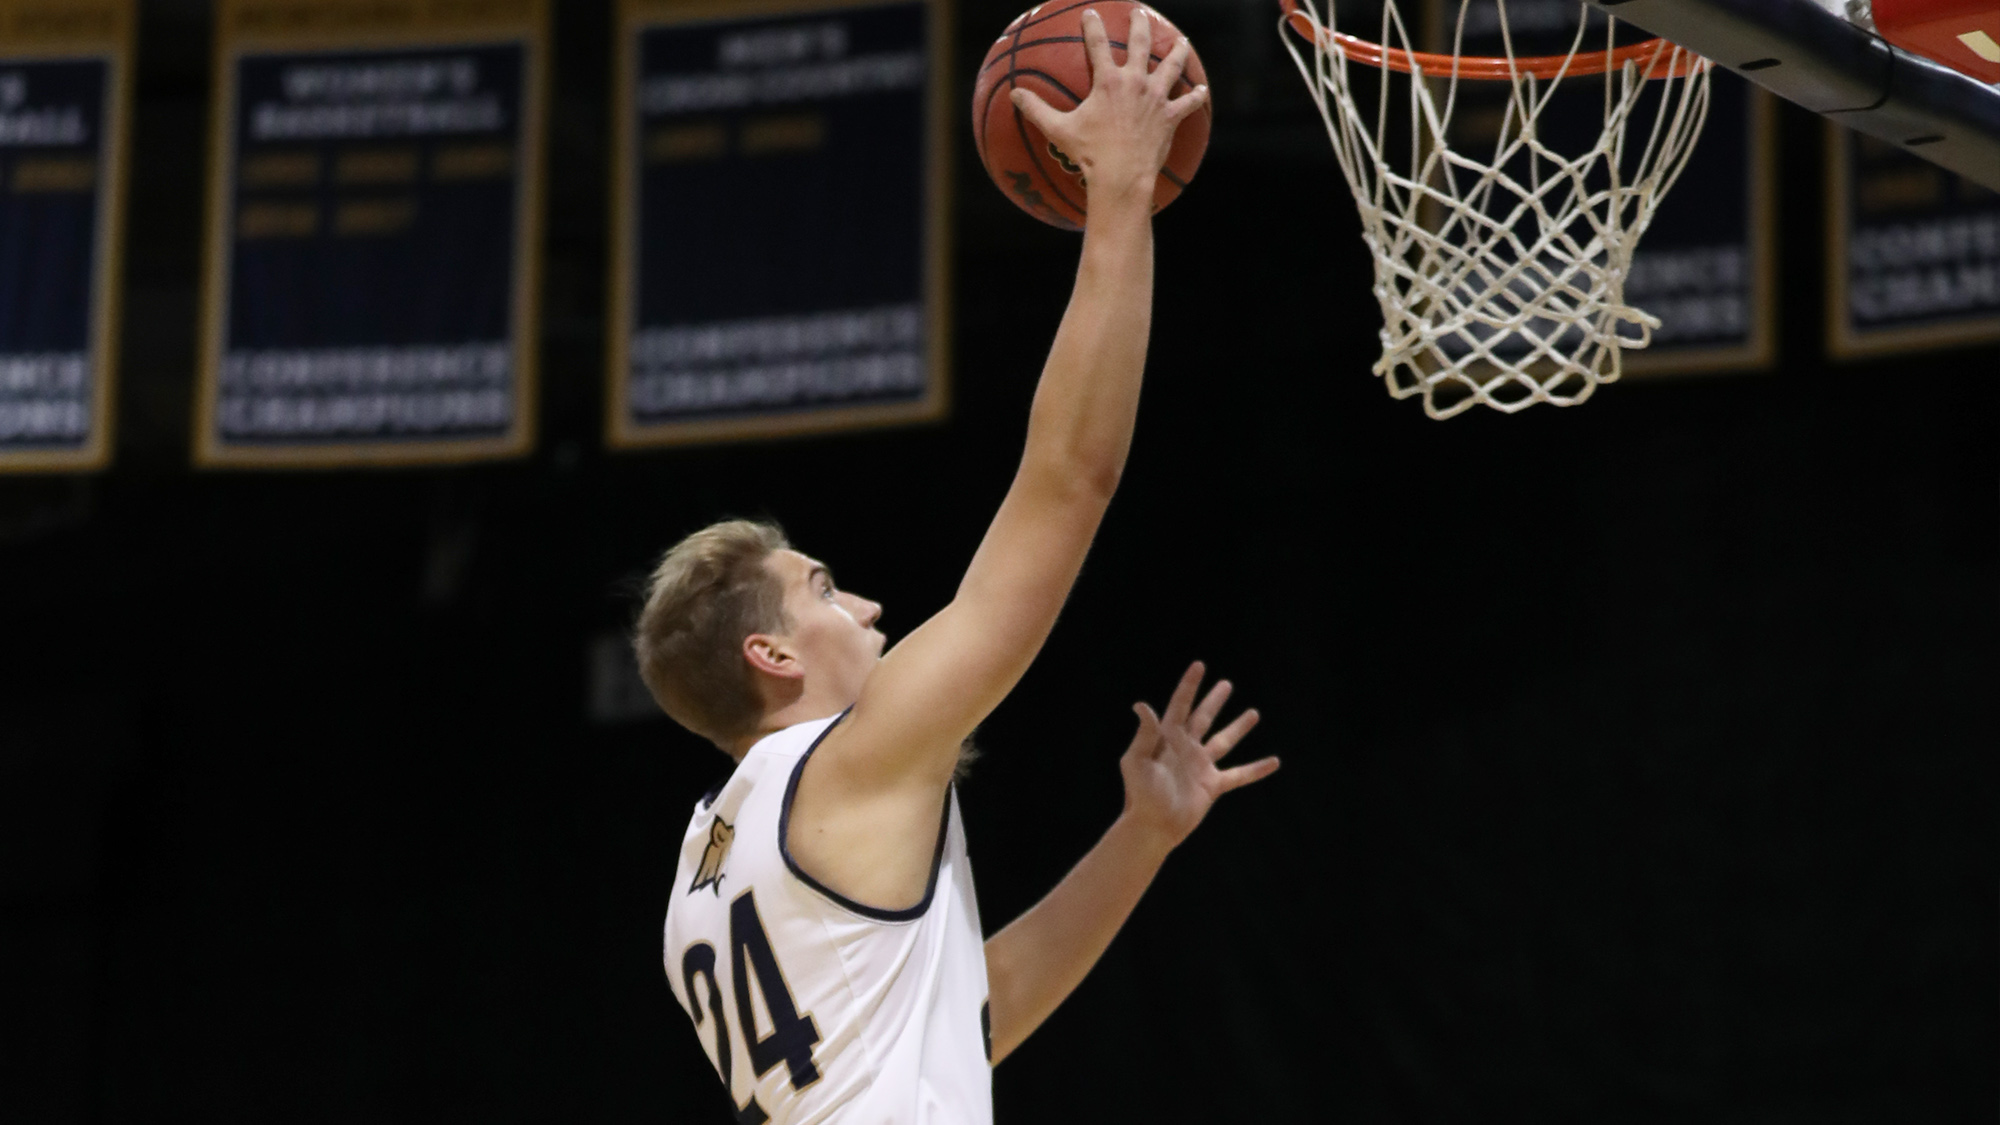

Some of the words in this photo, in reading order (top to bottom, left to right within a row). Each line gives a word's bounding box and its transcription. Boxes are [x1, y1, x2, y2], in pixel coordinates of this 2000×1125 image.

[250, 97, 505, 140] BASKETBALL
[634, 305, 922, 368] CONFERENCE
[222, 343, 512, 390] CONFERENCE
[632, 351, 922, 415] CHAMPIONS
[221, 390, 512, 437] CHAMPIONS
[682, 889, 822, 1125] 24
